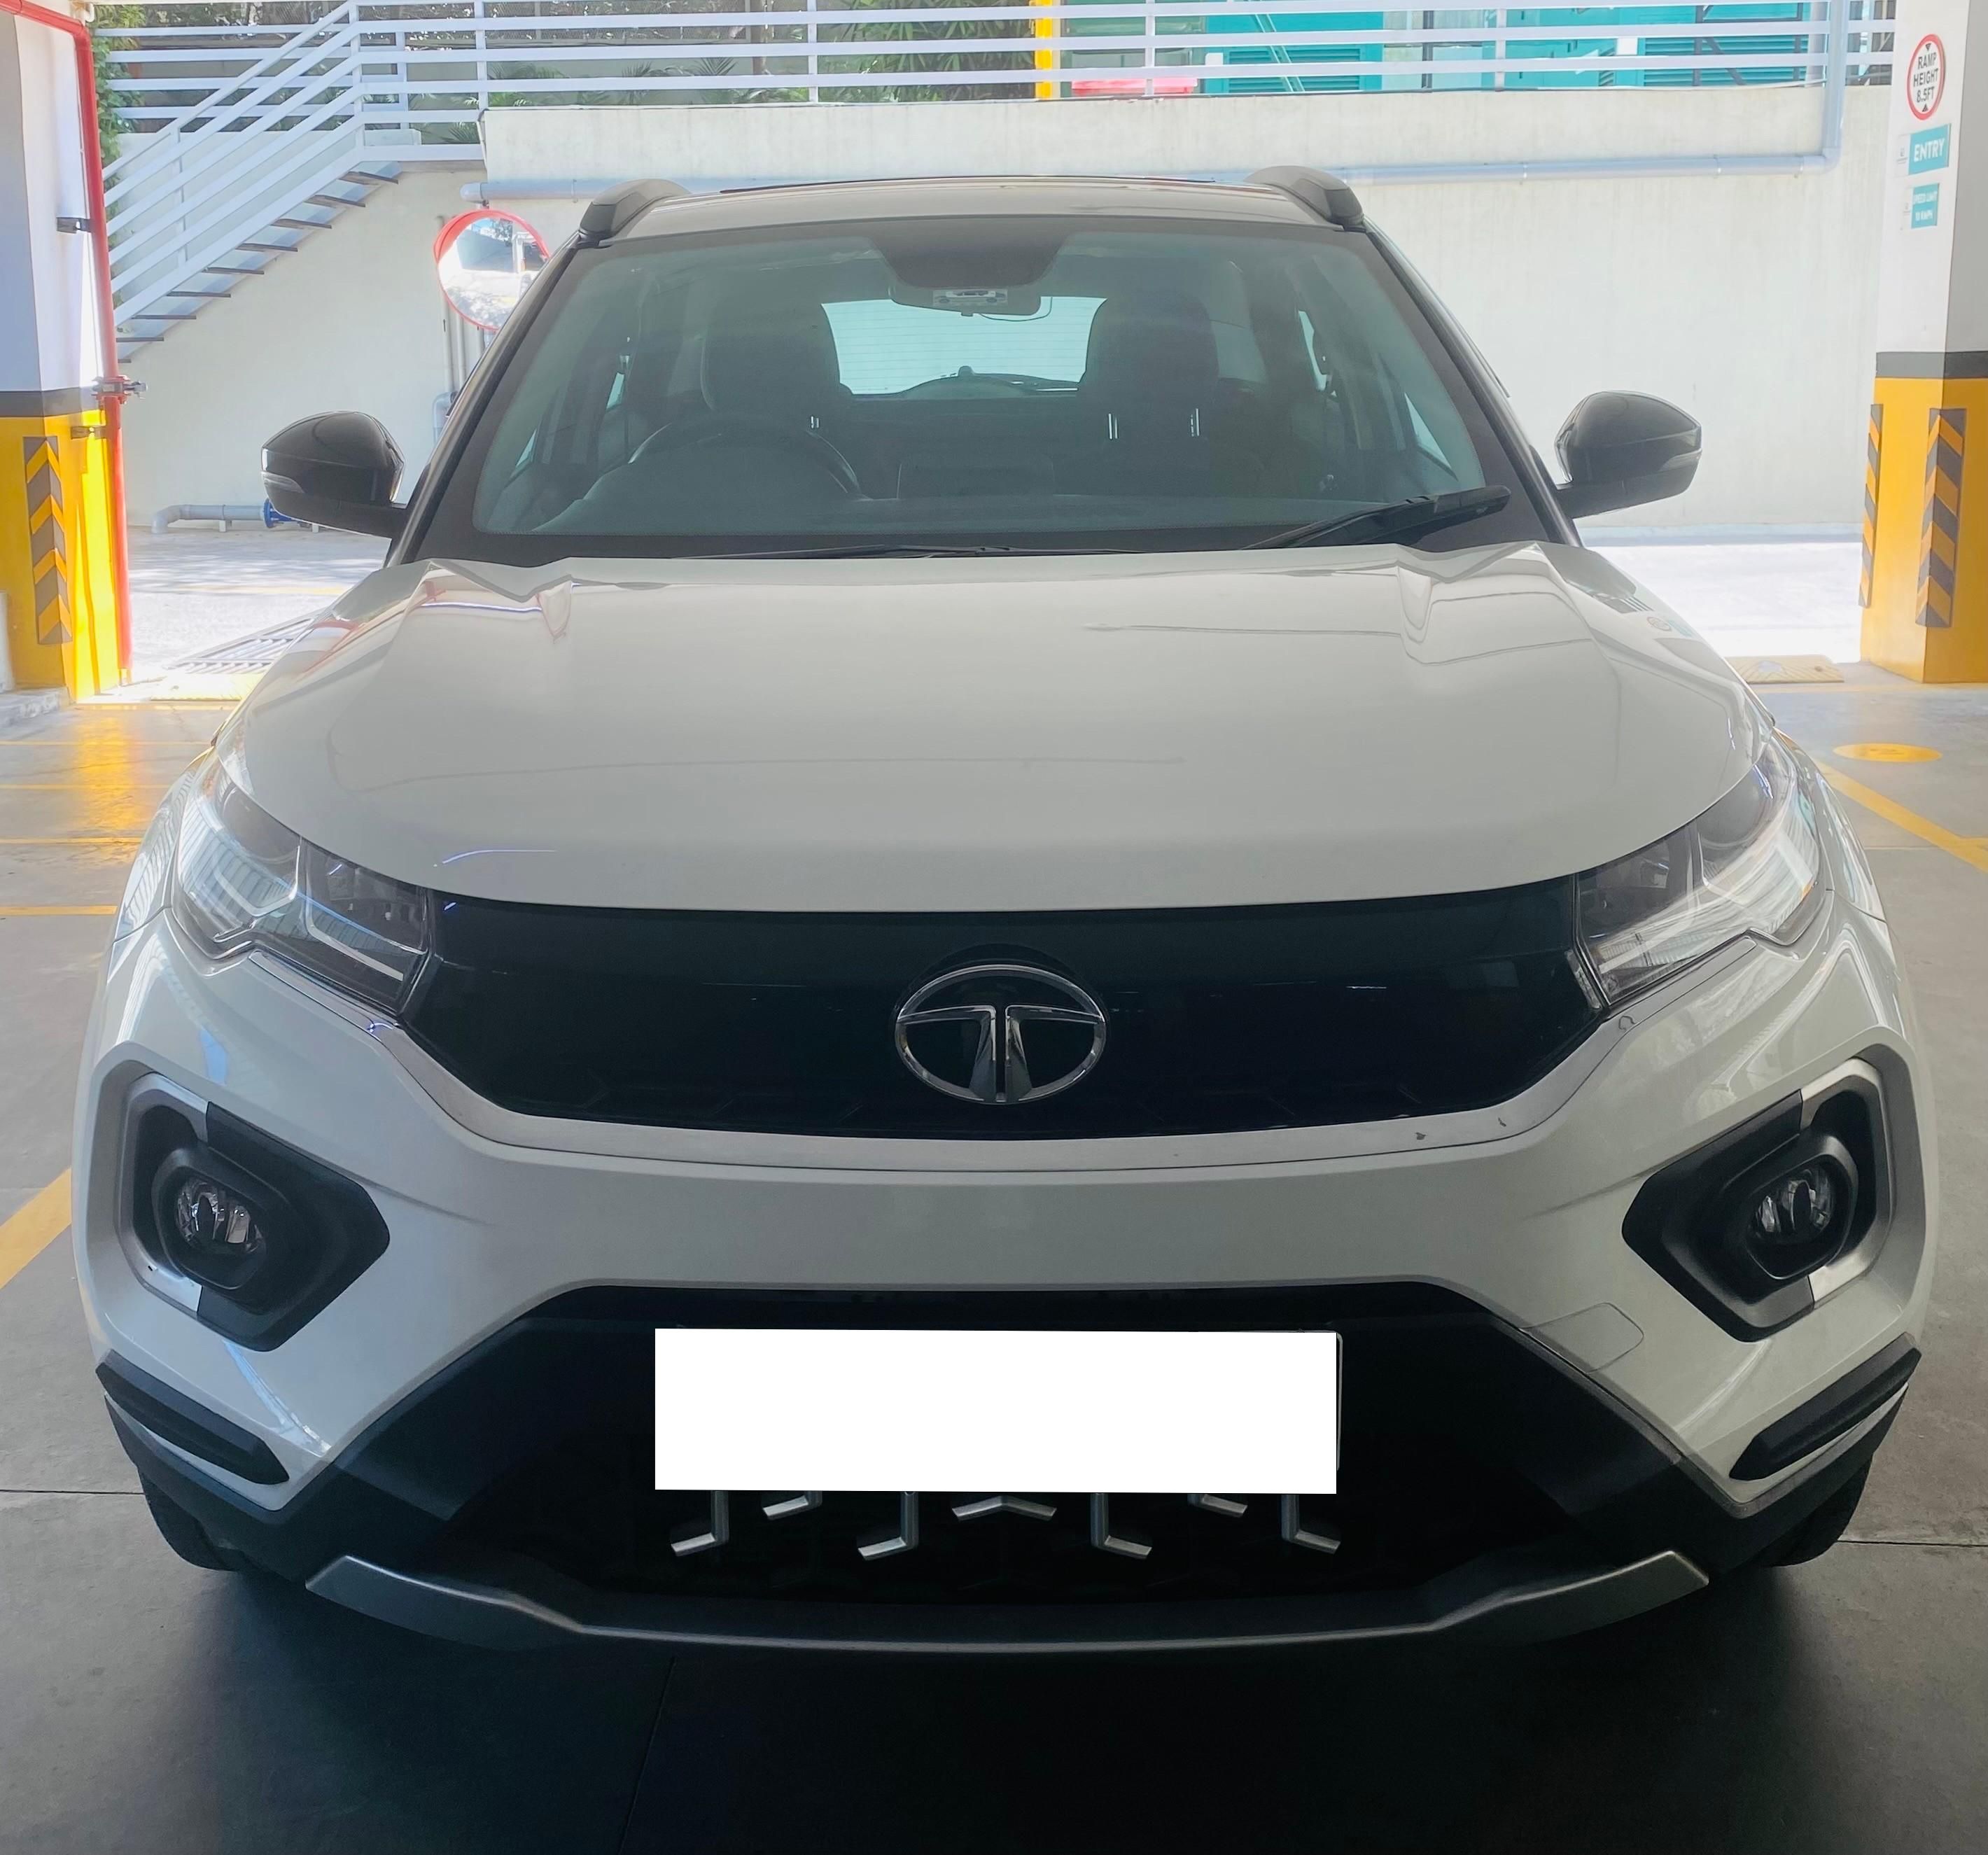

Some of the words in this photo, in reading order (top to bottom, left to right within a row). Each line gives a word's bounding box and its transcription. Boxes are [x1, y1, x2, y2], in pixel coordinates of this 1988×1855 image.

[1918, 52, 1937, 69] RAMP
[1913, 68, 1938, 87] HEIGHT
[1917, 86, 1934, 103] 8.5FT
[1914, 138, 1945, 162] ENTRY
